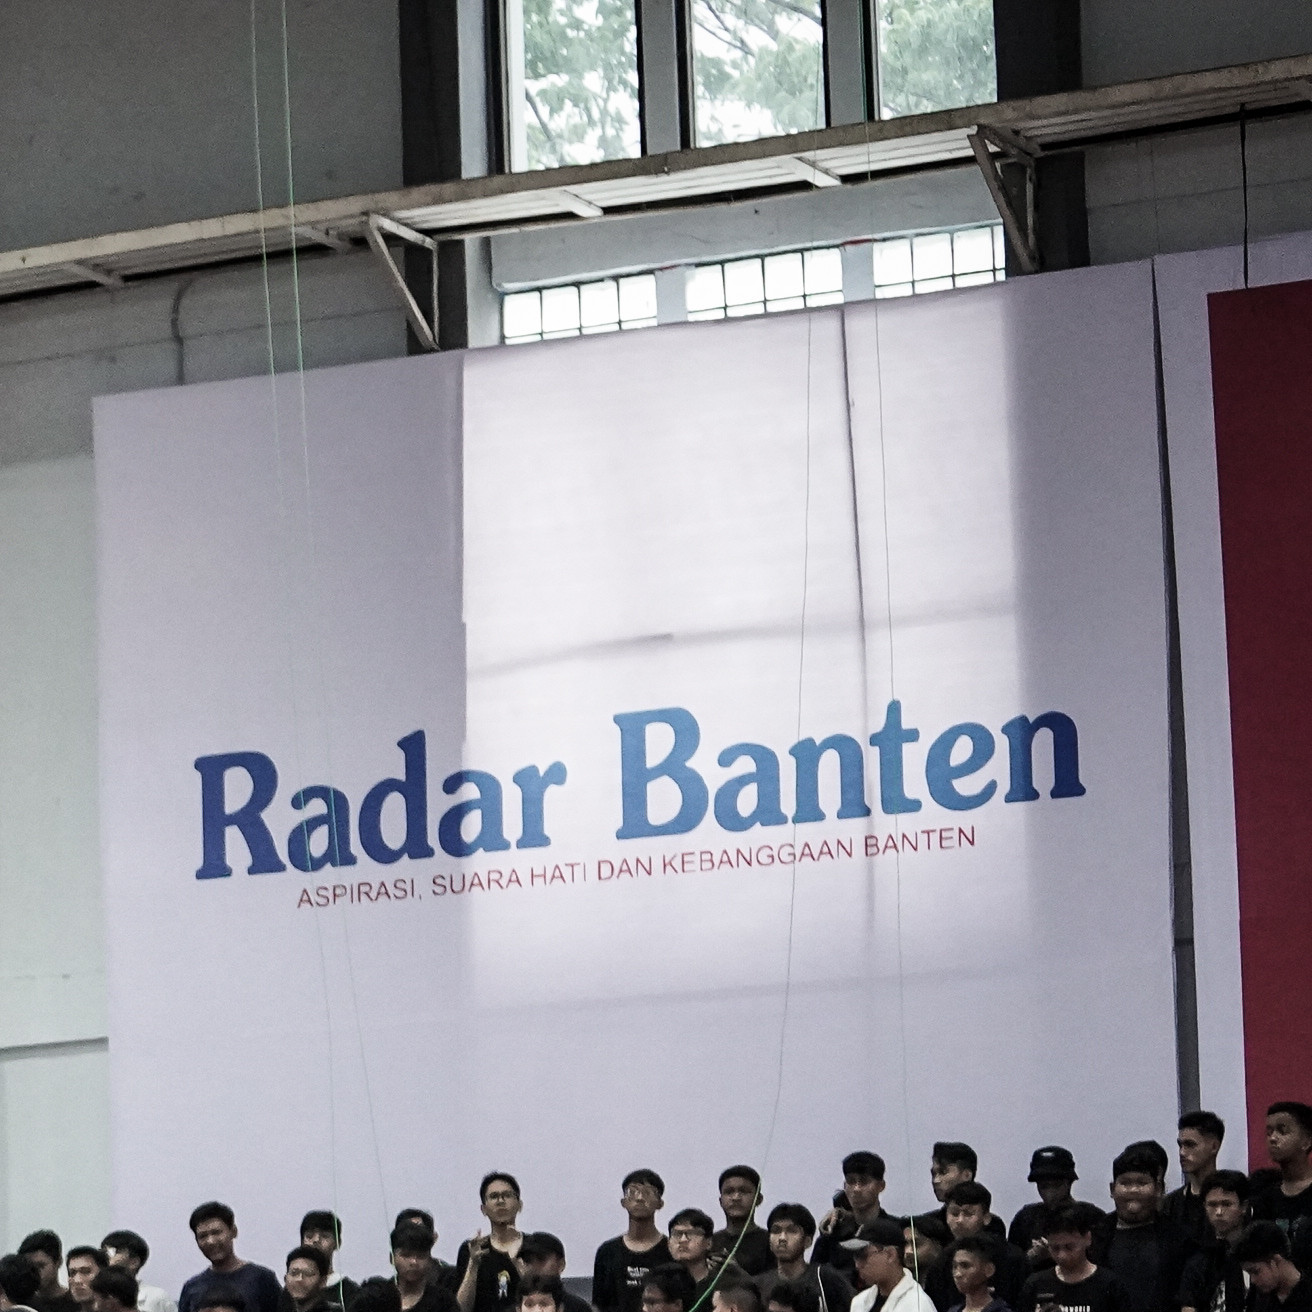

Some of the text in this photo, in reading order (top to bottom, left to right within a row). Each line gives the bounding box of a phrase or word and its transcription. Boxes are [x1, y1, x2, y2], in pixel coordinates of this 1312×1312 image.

[194, 700, 1086, 880] Radar Banten
[297, 824, 977, 909] ASPIRASI, SUARA HATI DAN KEBANGGAAN BANTEN
